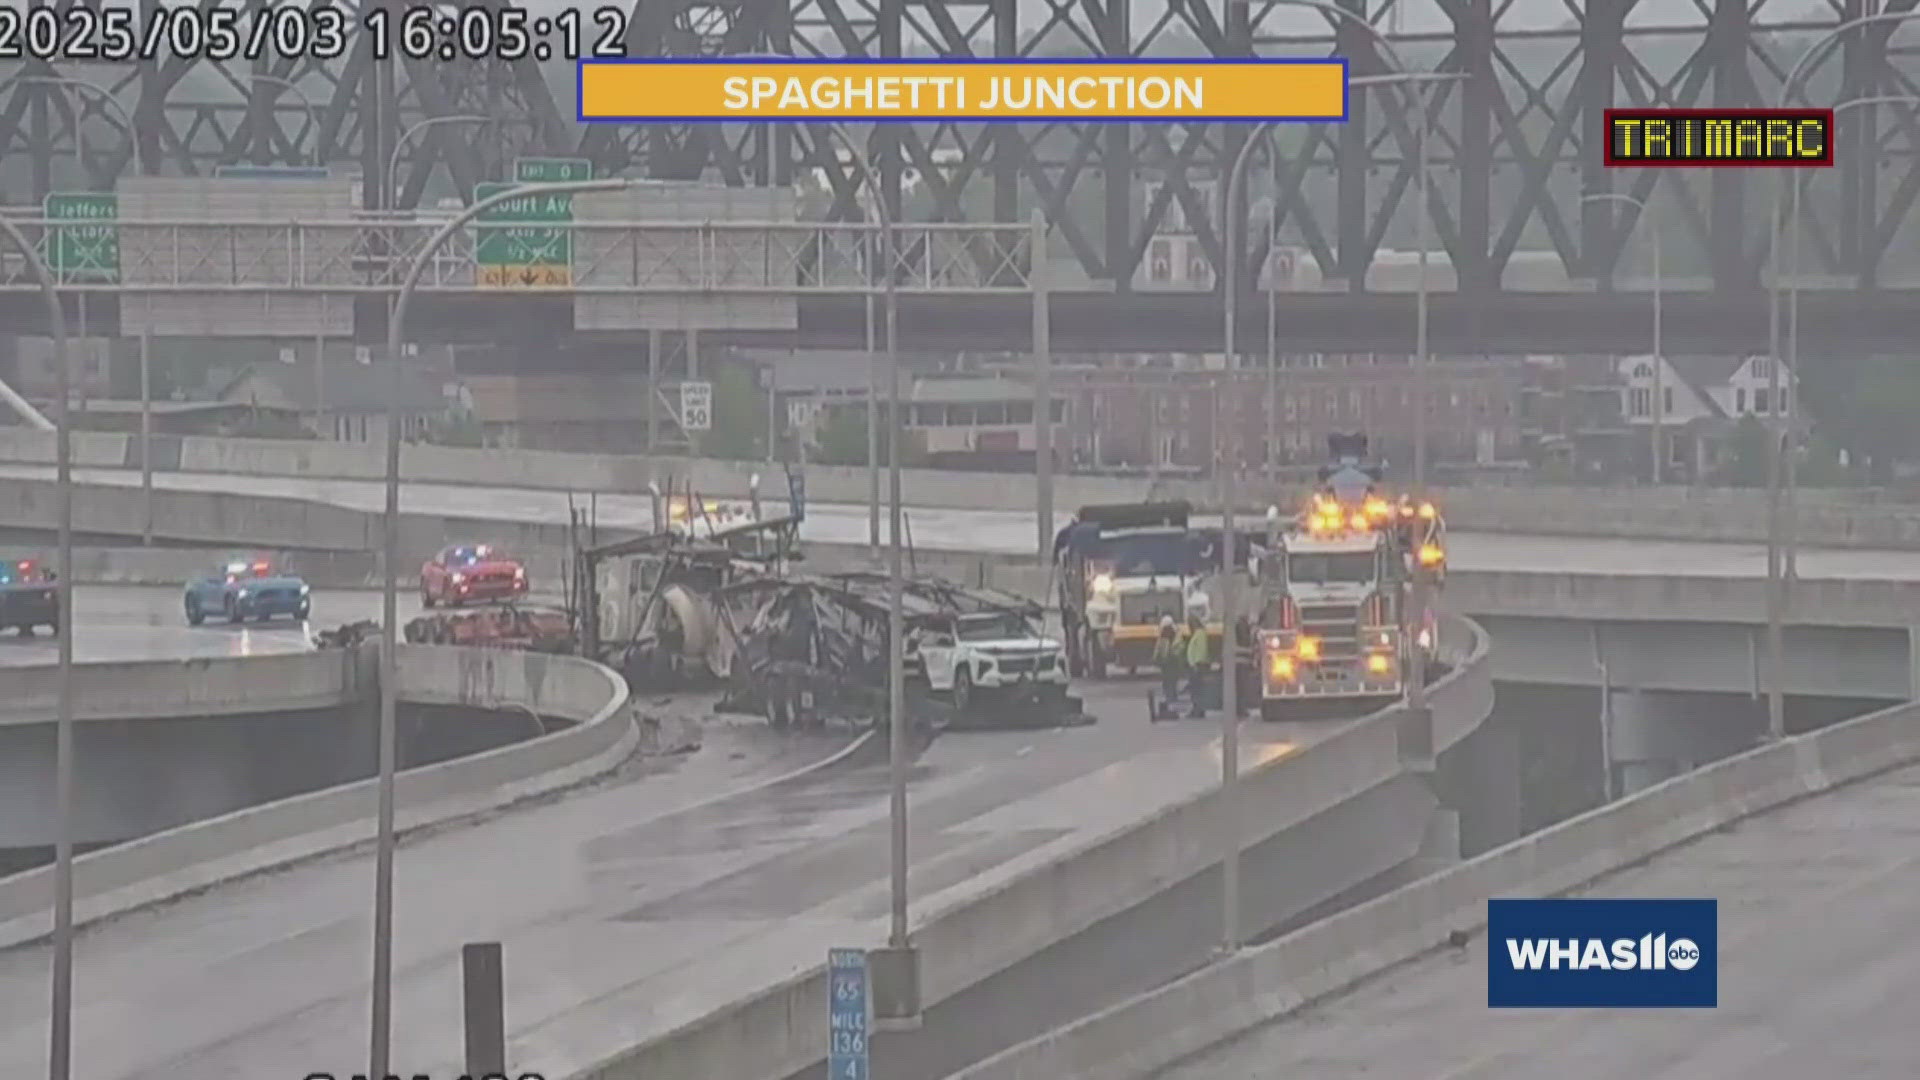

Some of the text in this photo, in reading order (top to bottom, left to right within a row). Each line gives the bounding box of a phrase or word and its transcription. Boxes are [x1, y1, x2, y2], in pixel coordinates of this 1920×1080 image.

[685, 408, 707, 426] 50
[837, 981, 859, 1000] 65
[831, 1012, 864, 1030] MILE
[833, 1031, 863, 1053] 136
[845, 1060, 857, 1079] 4
